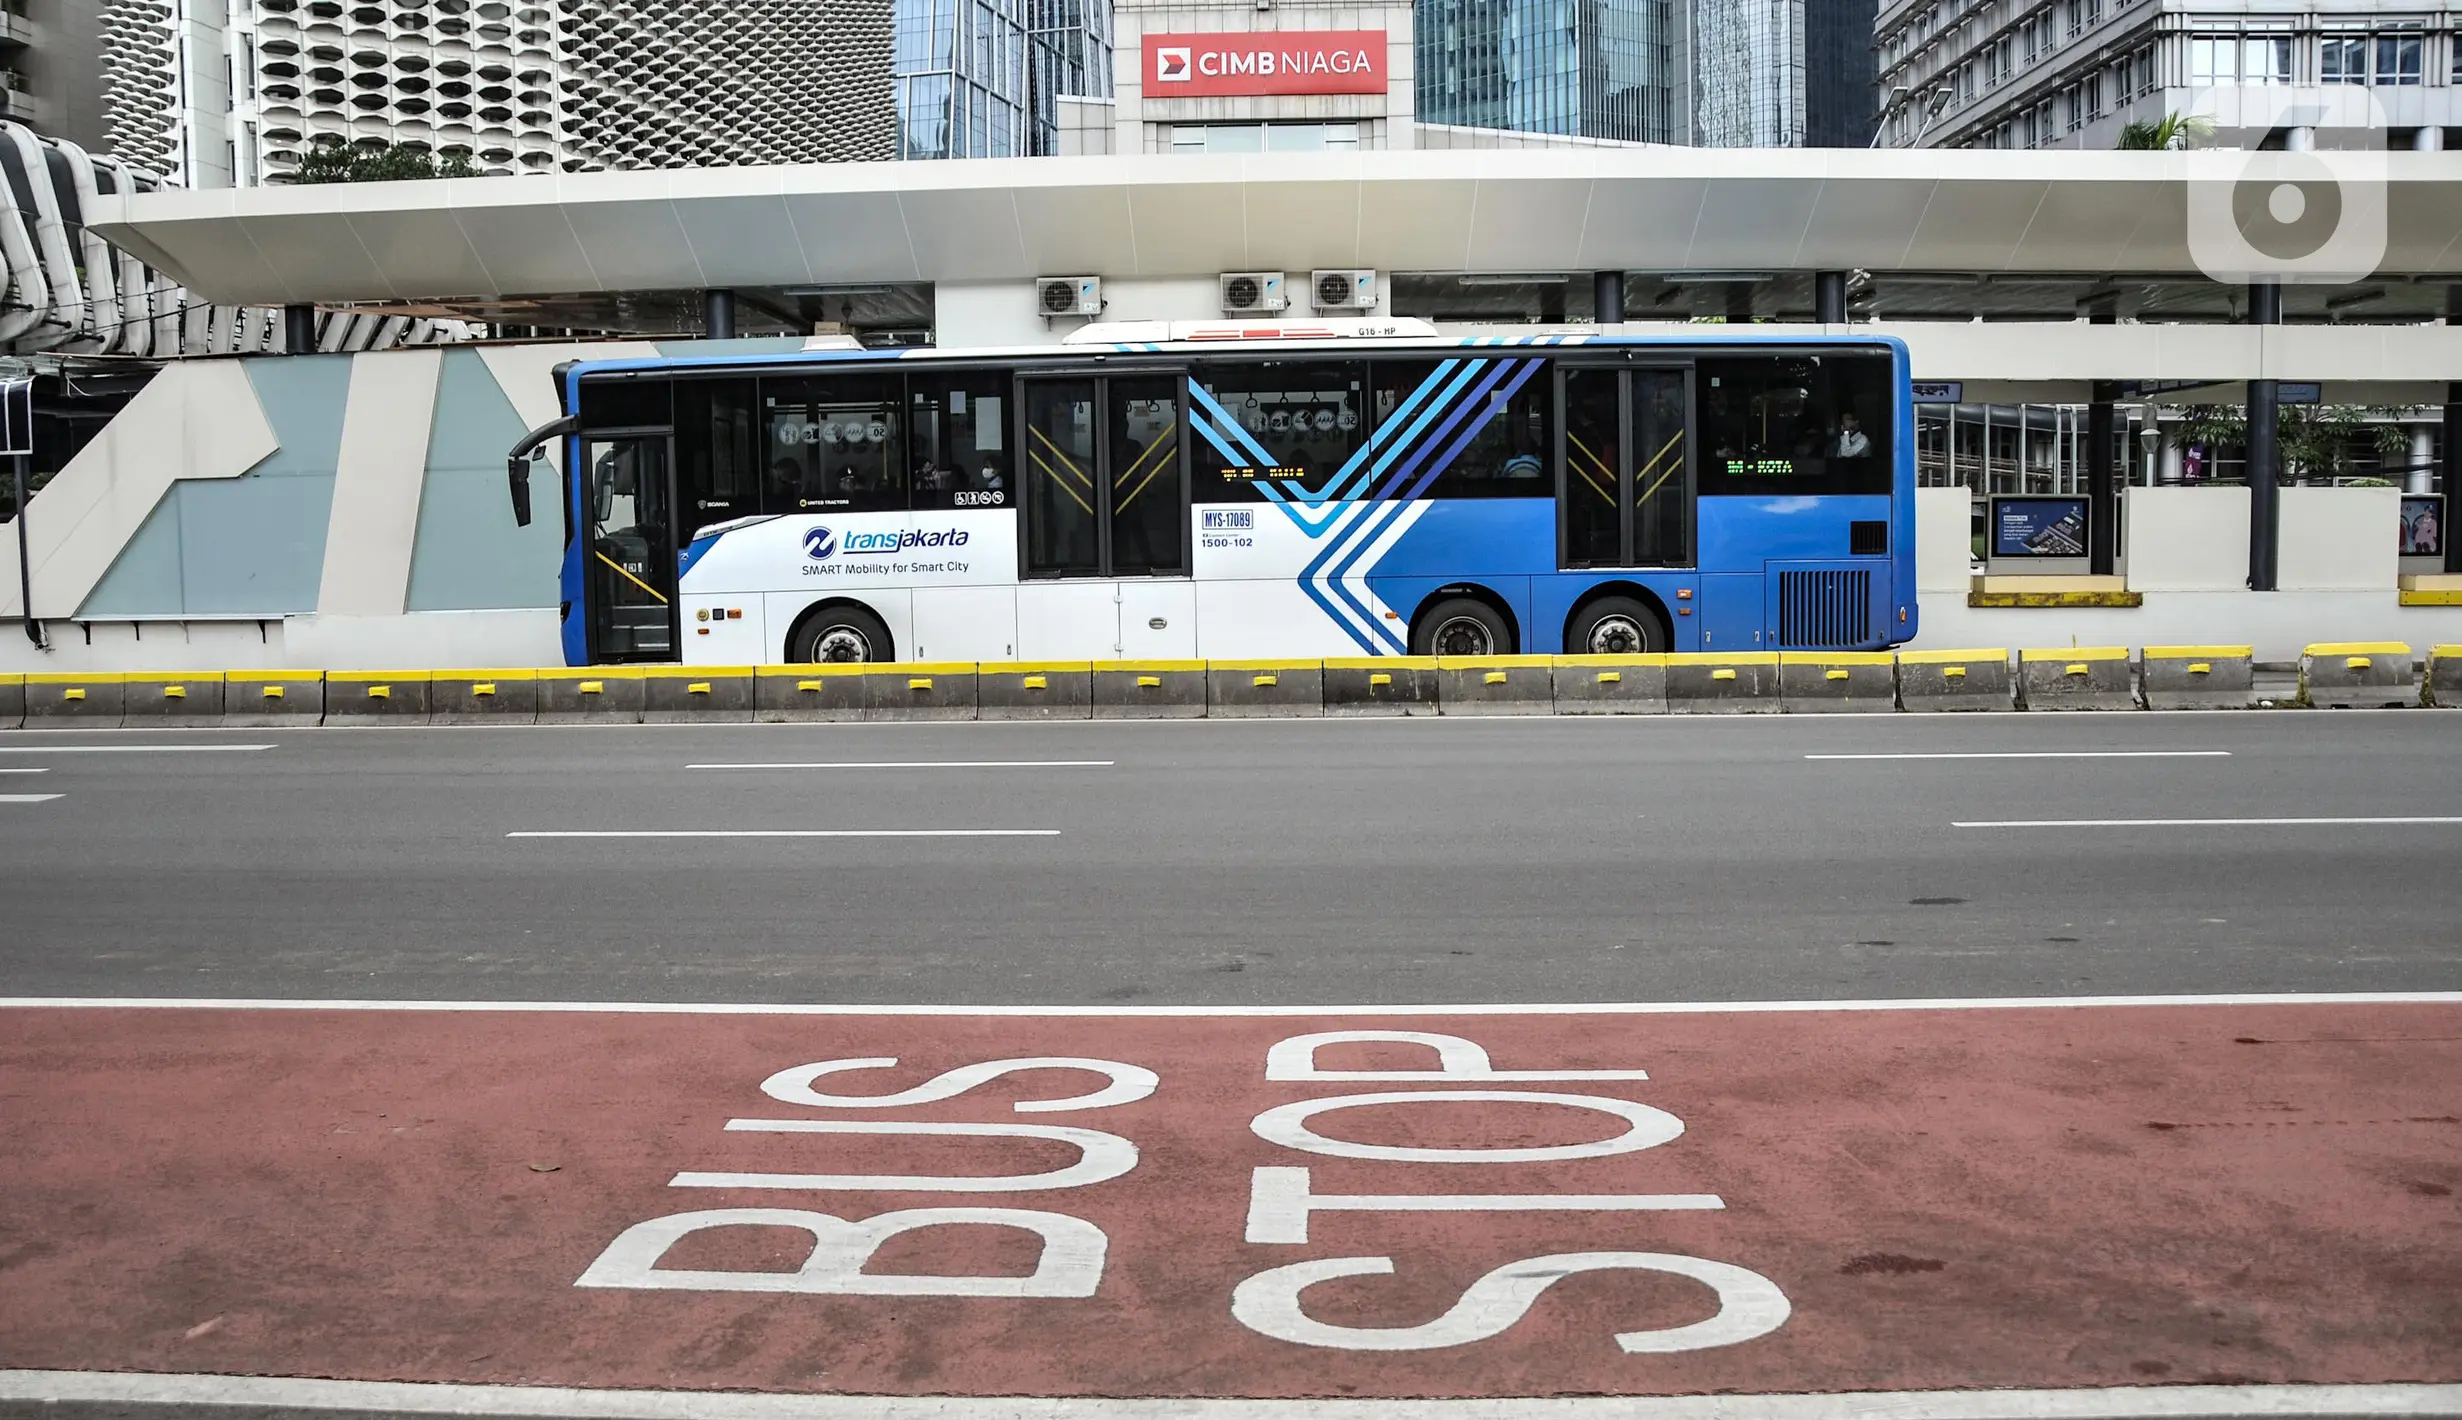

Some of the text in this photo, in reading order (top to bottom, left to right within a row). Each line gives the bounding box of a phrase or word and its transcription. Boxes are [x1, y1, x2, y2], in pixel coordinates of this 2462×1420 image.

[1199, 50, 1372, 76] CIMB NIAGA
[1384, 327, 1396, 335] HP
[1757, 460, 1793, 473] KOTA
[1205, 512, 1251, 527] MYS-17089
[843, 528, 969, 554] transjakarta
[1202, 538, 1253, 548] 1500-102
[802, 561, 969, 575] SMART Mobility for Smart City
[573, 1057, 1159, 1297] BUS
[1232, 1030, 1791, 1353] STOP
